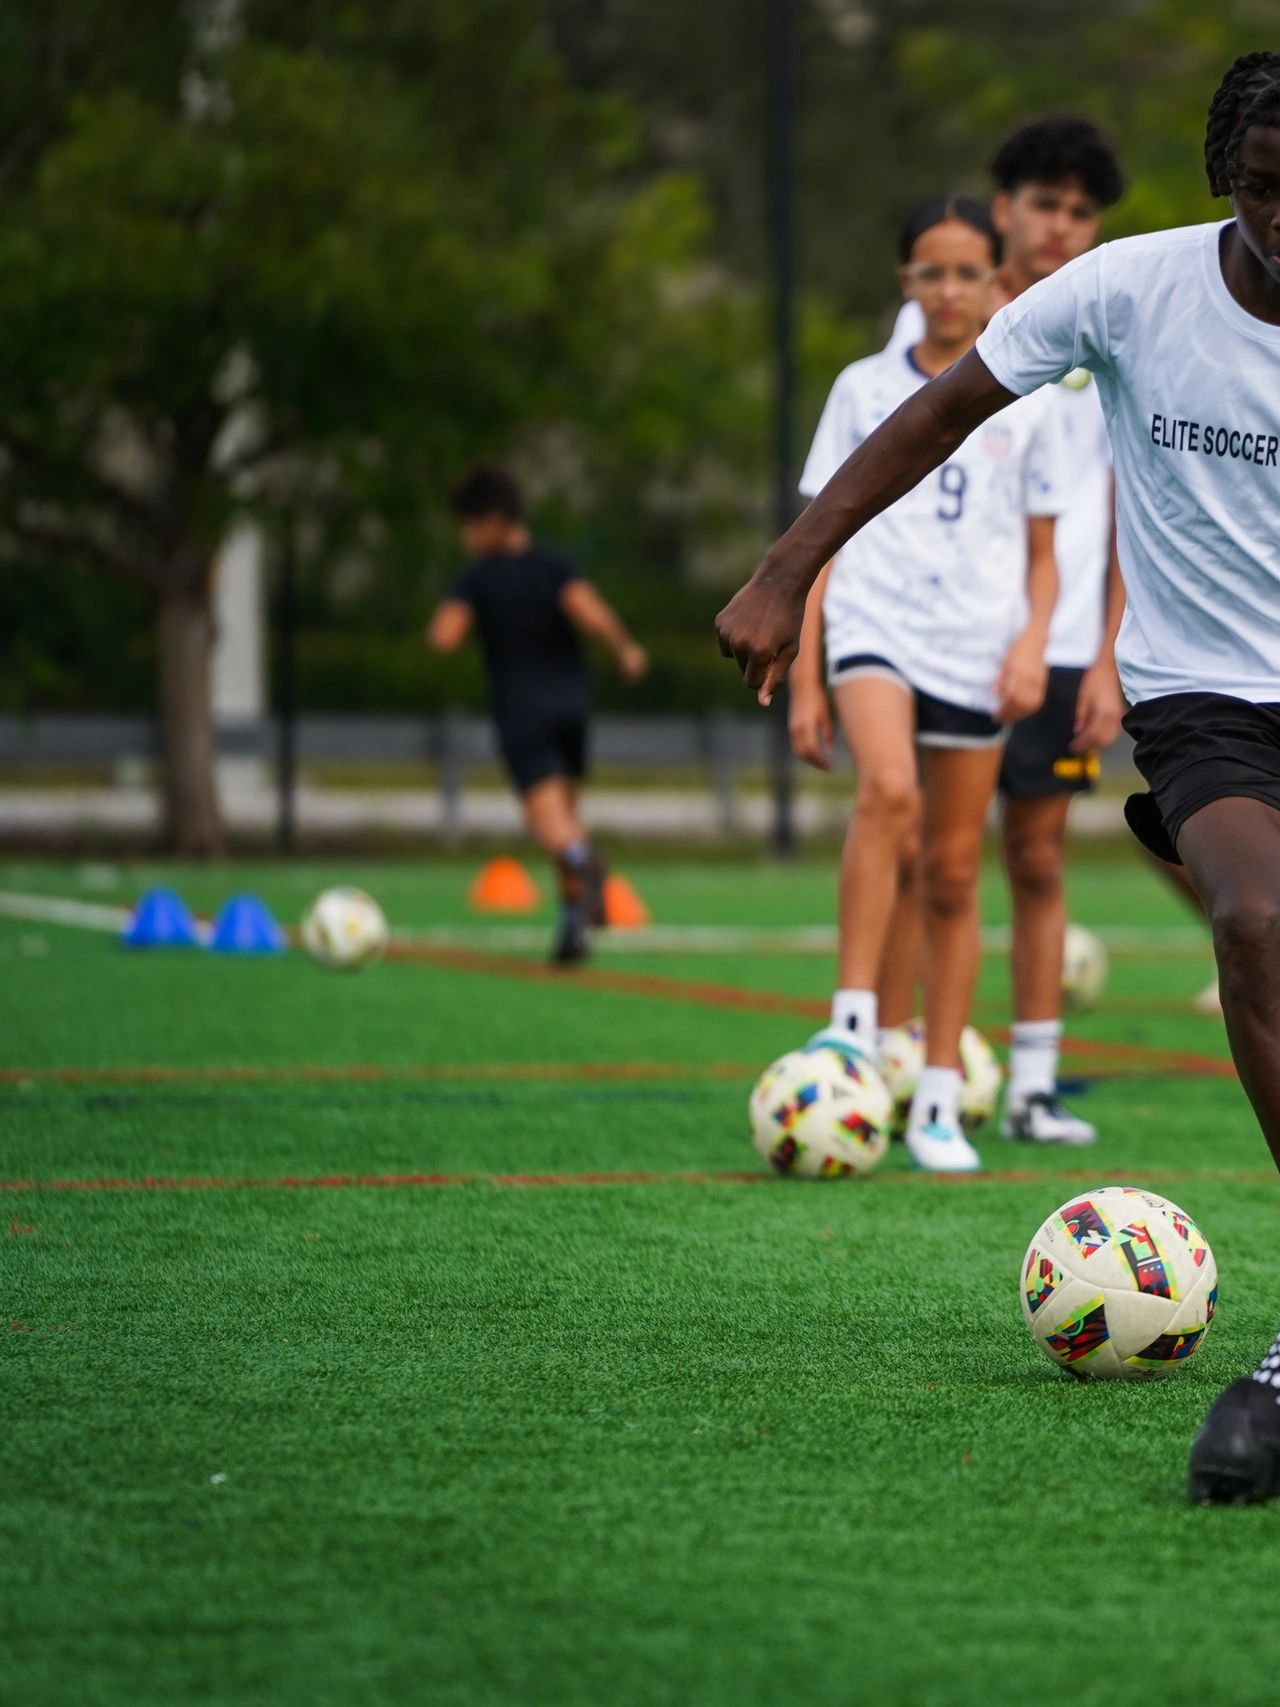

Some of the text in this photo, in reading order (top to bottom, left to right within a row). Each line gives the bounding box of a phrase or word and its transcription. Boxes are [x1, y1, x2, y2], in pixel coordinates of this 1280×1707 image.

[1151, 414, 1199, 452] ELITE
[1203, 426, 1279, 466] SOCCER
[936, 463, 968, 522] 9
